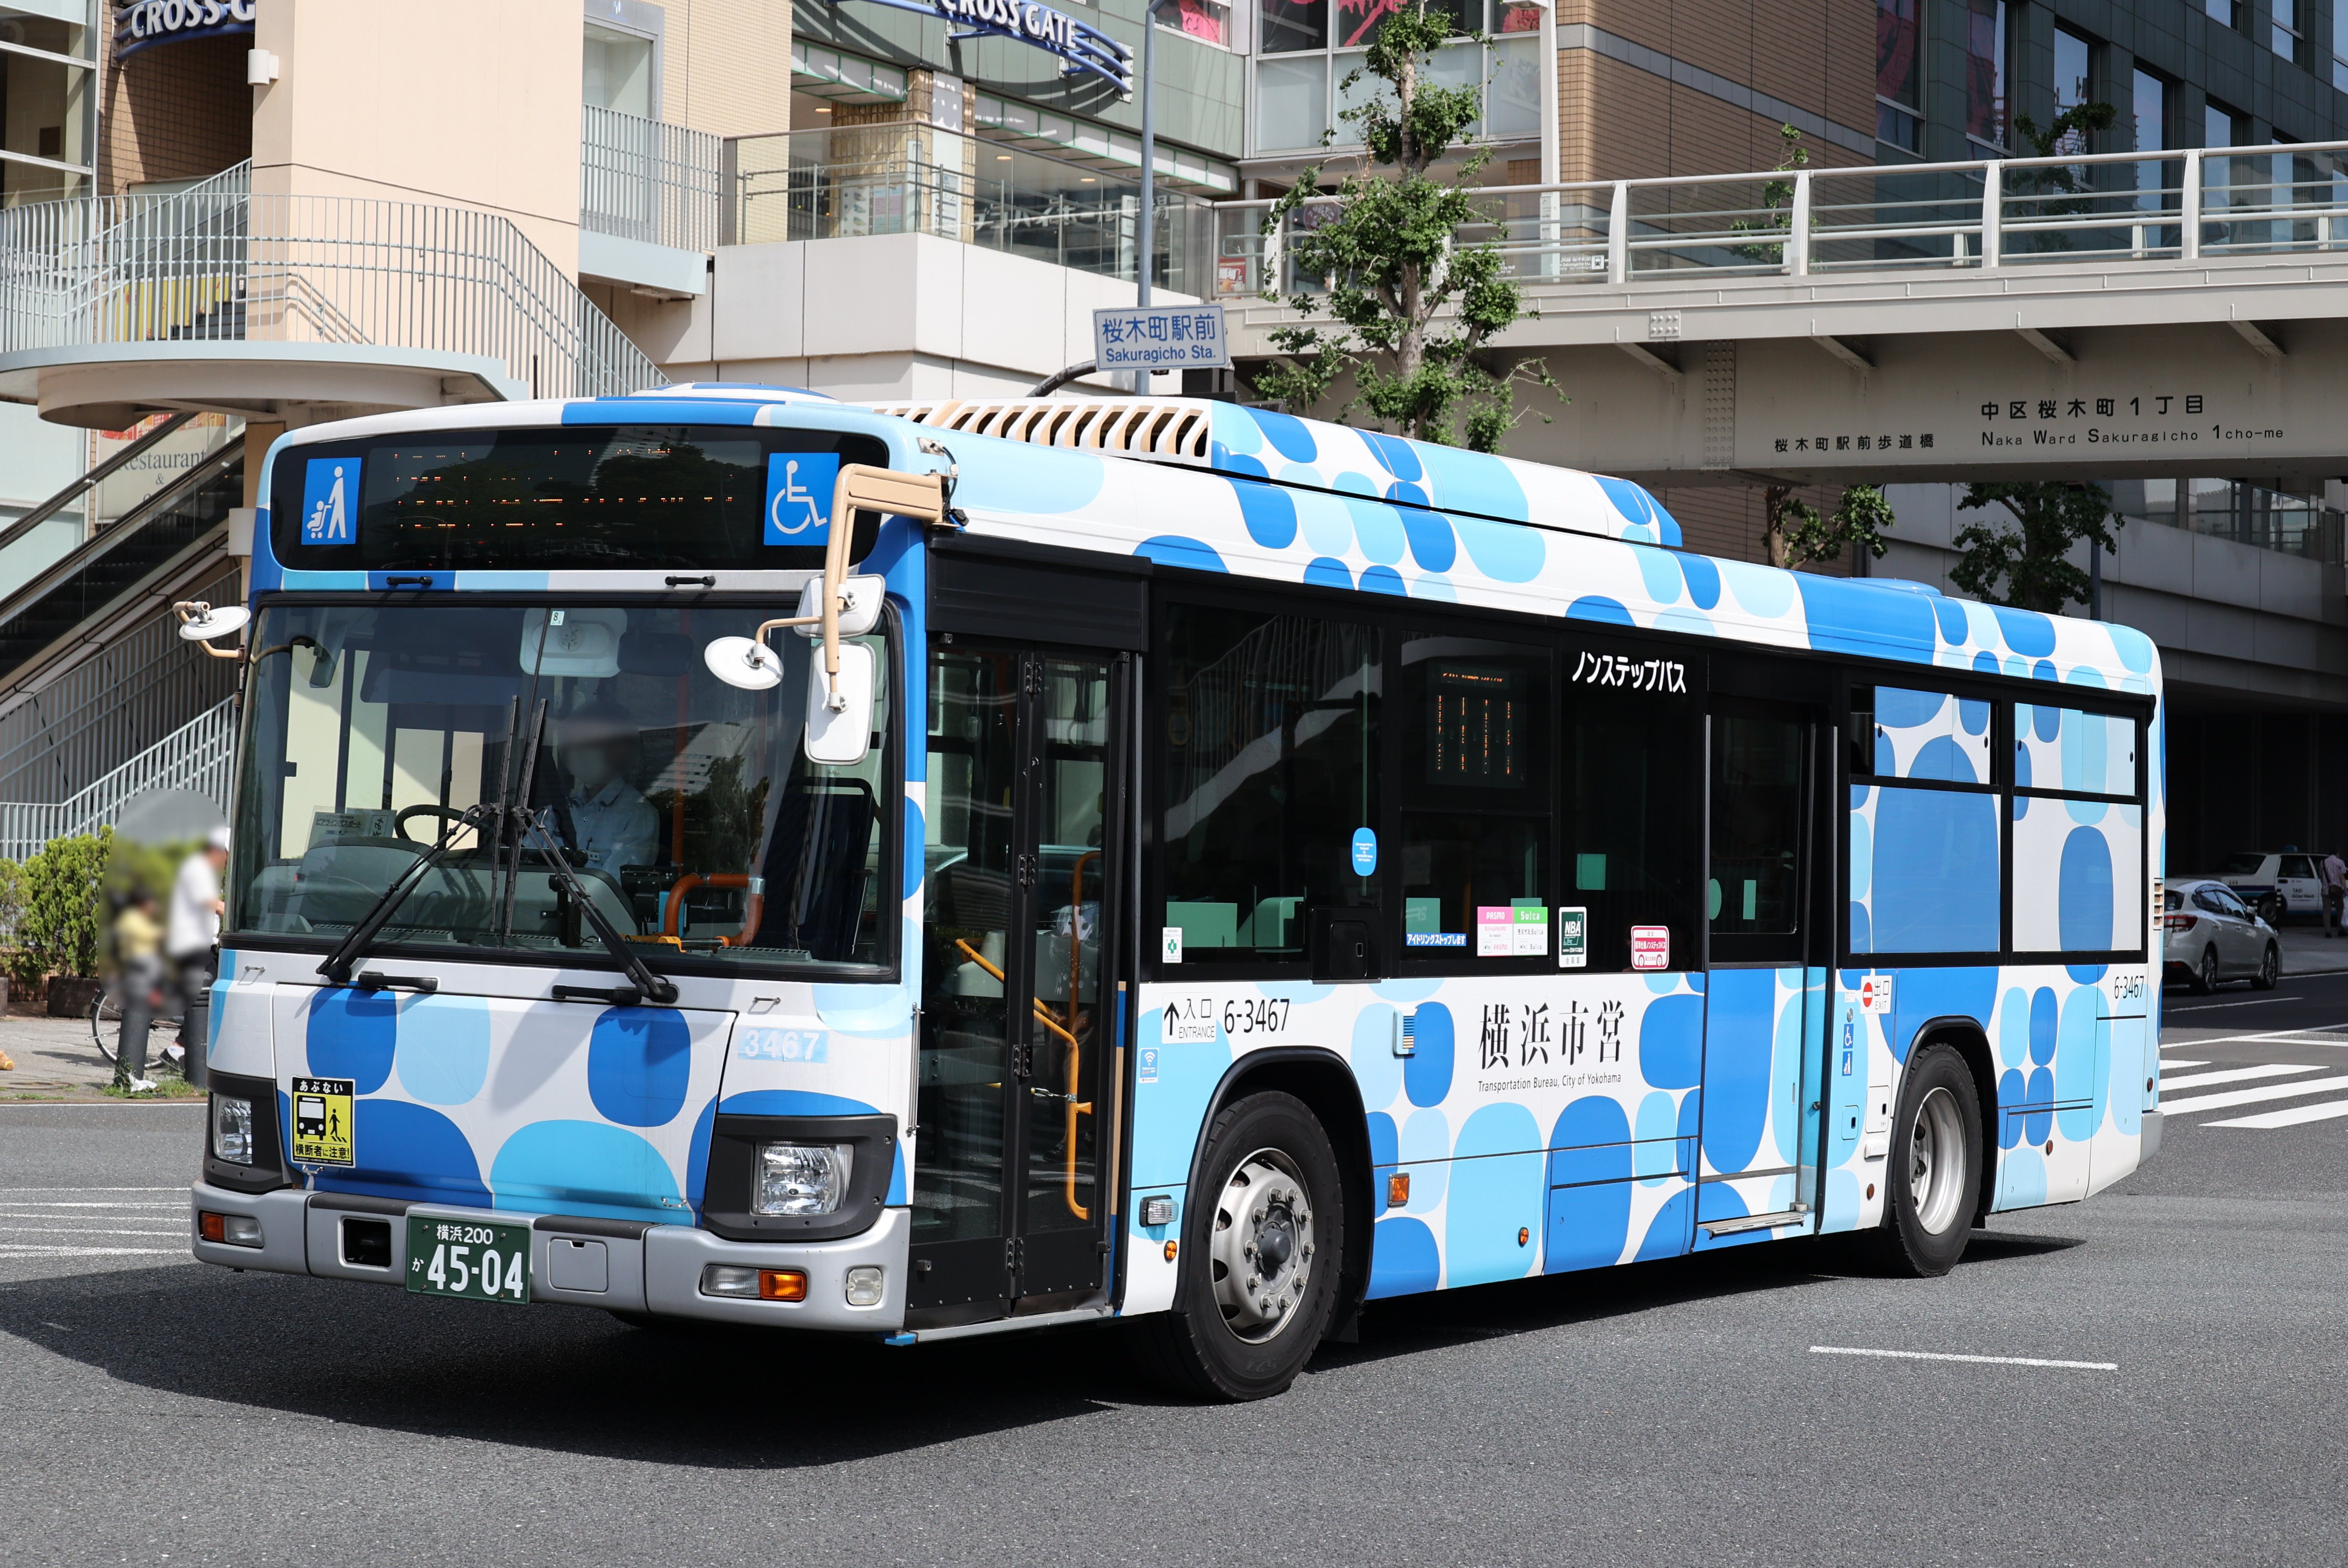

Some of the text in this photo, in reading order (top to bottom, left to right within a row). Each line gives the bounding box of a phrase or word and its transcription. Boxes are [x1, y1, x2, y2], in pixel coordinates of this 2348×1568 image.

[132, 0, 221, 38] CROSS
[1026, 4, 1076, 49] GATE
[1103, 313, 1216, 344] 桜木町駅前
[1106, 344, 1216, 363] Sakuragicho Sta.
[1982, 395, 2203, 421] 中区桜木町1丁目
[1774, 433, 1934, 453] 桜木町駅前歩道橋
[1982, 432, 2022, 445] Naka
[2033, 429, 2076, 444] Ward
[2088, 428, 2198, 443] Sakuragicho
[156, 472, 164, 485] &
[553, 612, 559, 621] 8
[1572, 651, 1686, 694] ノンステップバス
[1486, 911, 1505, 920] PASMO
[1521, 911, 1540, 920] Suica
[1565, 921, 1582, 934] NBA
[1407, 934, 1466, 945] アイドリングストップします
[1874, 980, 1889, 996] 出口
[2114, 975, 2144, 999] 6-3467
[1183, 998, 1212, 1020] 入口
[1875, 1000, 1887, 1010] EXIT
[1224, 998, 1290, 1034] 6-3467
[1179, 1026, 1215, 1039] ENTRANCE
[1478, 999, 1625, 1070] 横浜市営
[744, 1030, 820, 1060] 3467
[299, 1080, 343, 1094] あぶない
[1478, 1072, 1621, 1094] Transportation Bureau, City of Yokohama
[295, 1143, 350, 1159] 横断者に注意!
[411, 1244, 523, 1299] か 45-04
